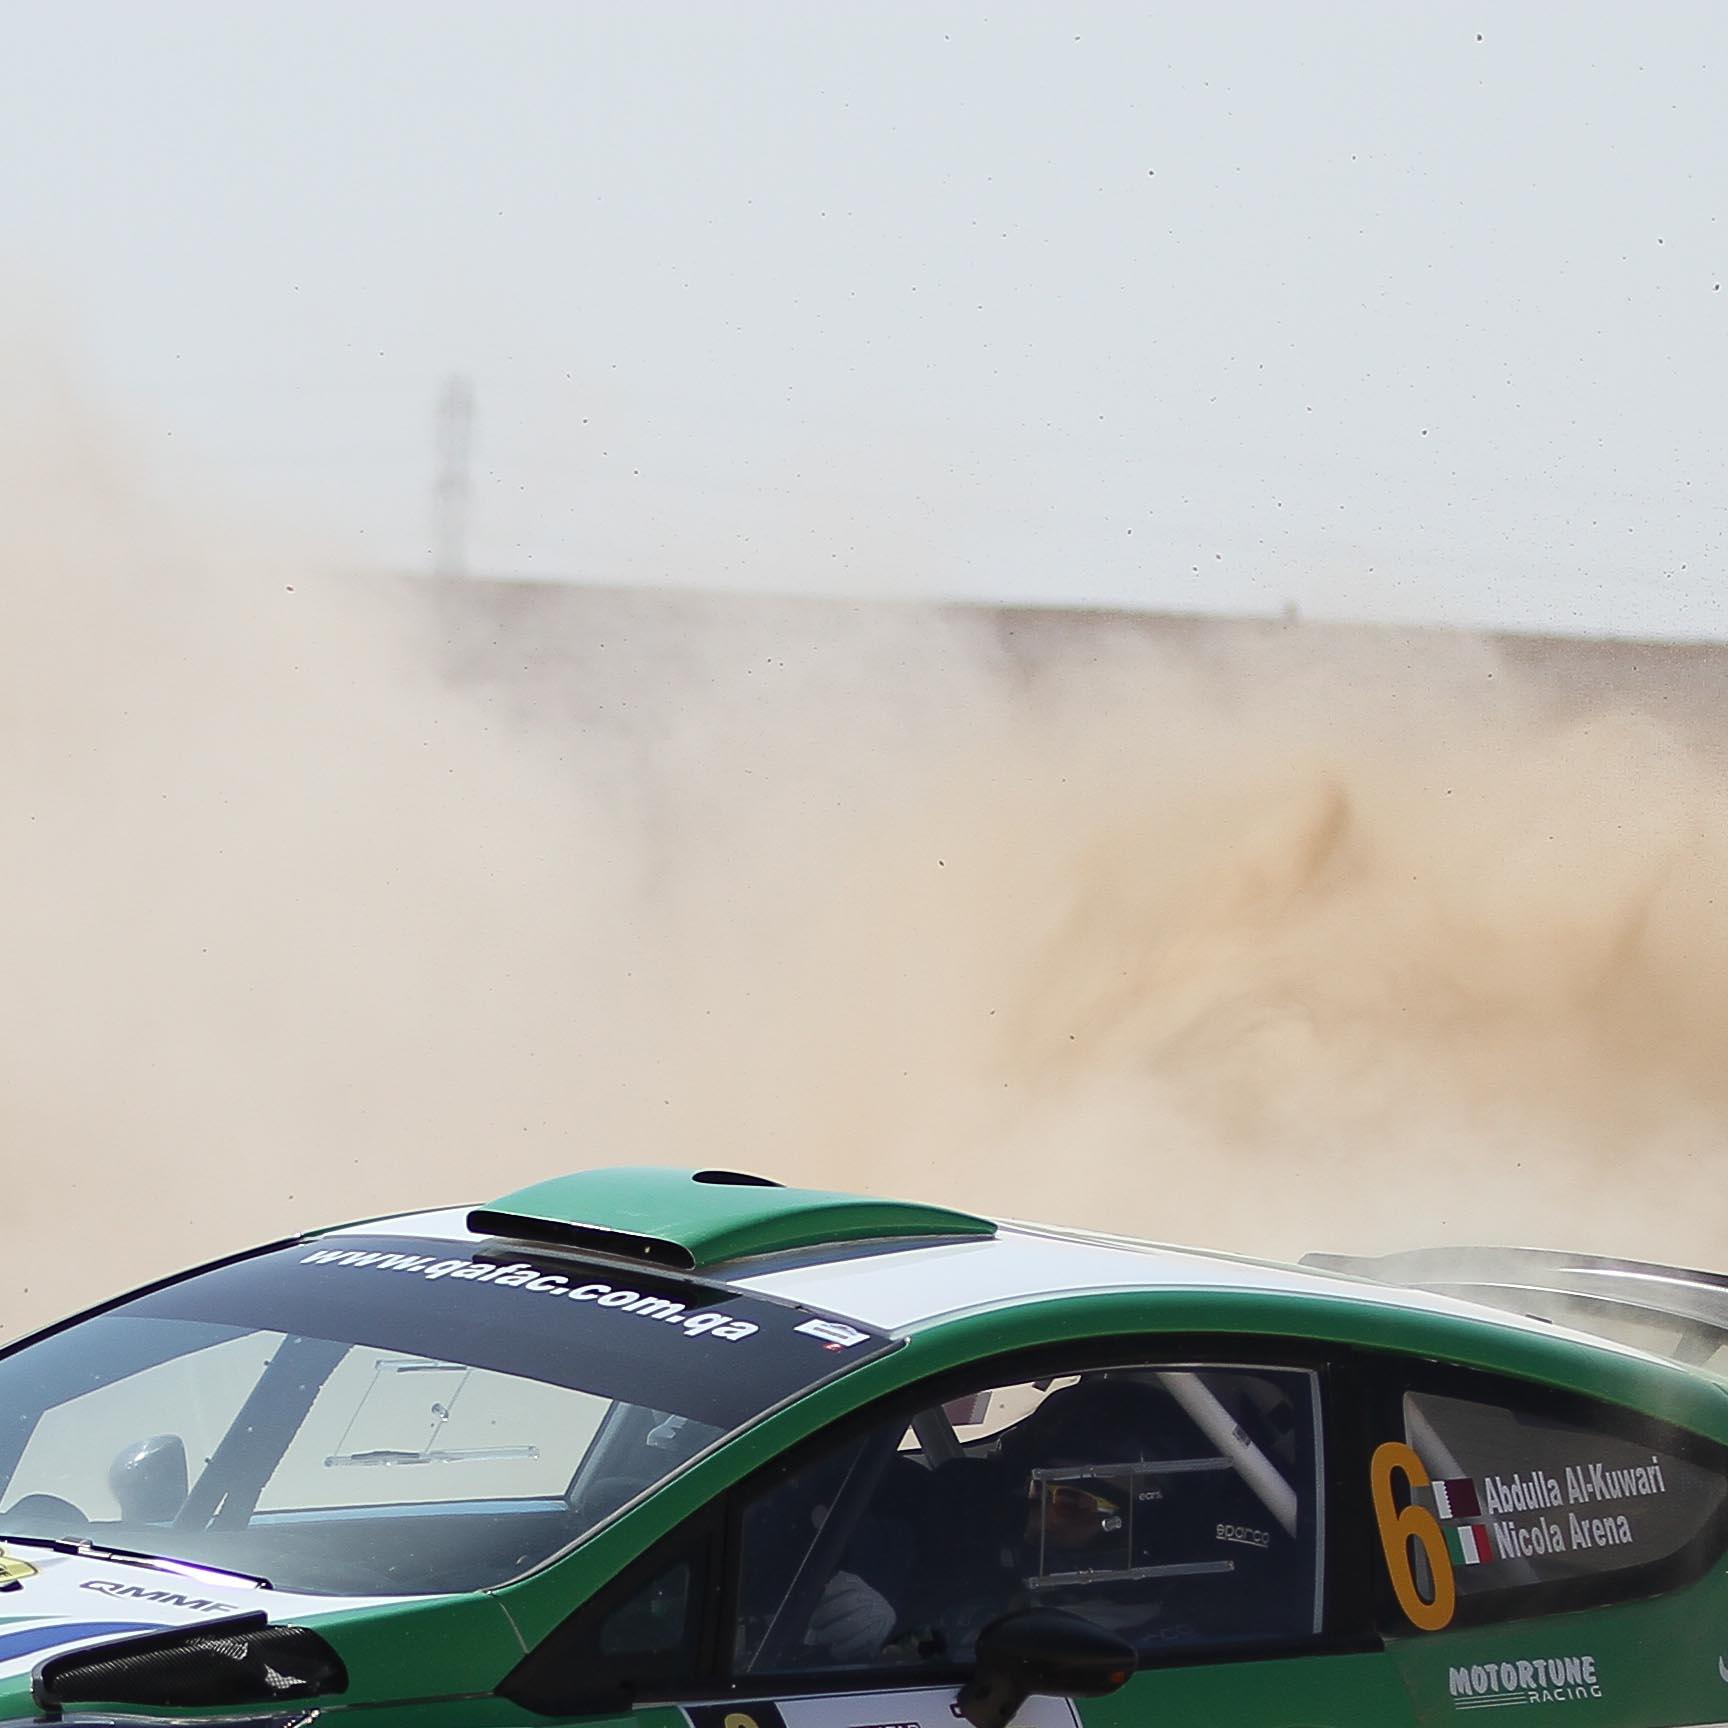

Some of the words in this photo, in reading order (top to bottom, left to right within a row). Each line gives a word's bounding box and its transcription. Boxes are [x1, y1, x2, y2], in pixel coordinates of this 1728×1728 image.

[299, 1245, 760, 1342] www.qafac.com.qa
[1484, 1470, 1563, 1515] Abdulla
[1566, 1455, 1667, 1504] Al-Kuwari
[1372, 1441, 1456, 1631] 6
[1494, 1519, 1563, 1560] Nicola
[1570, 1512, 1632, 1552] Arena
[79, 1579, 239, 1613] QMMF
[1448, 1655, 1596, 1698] MOTORTUNE
